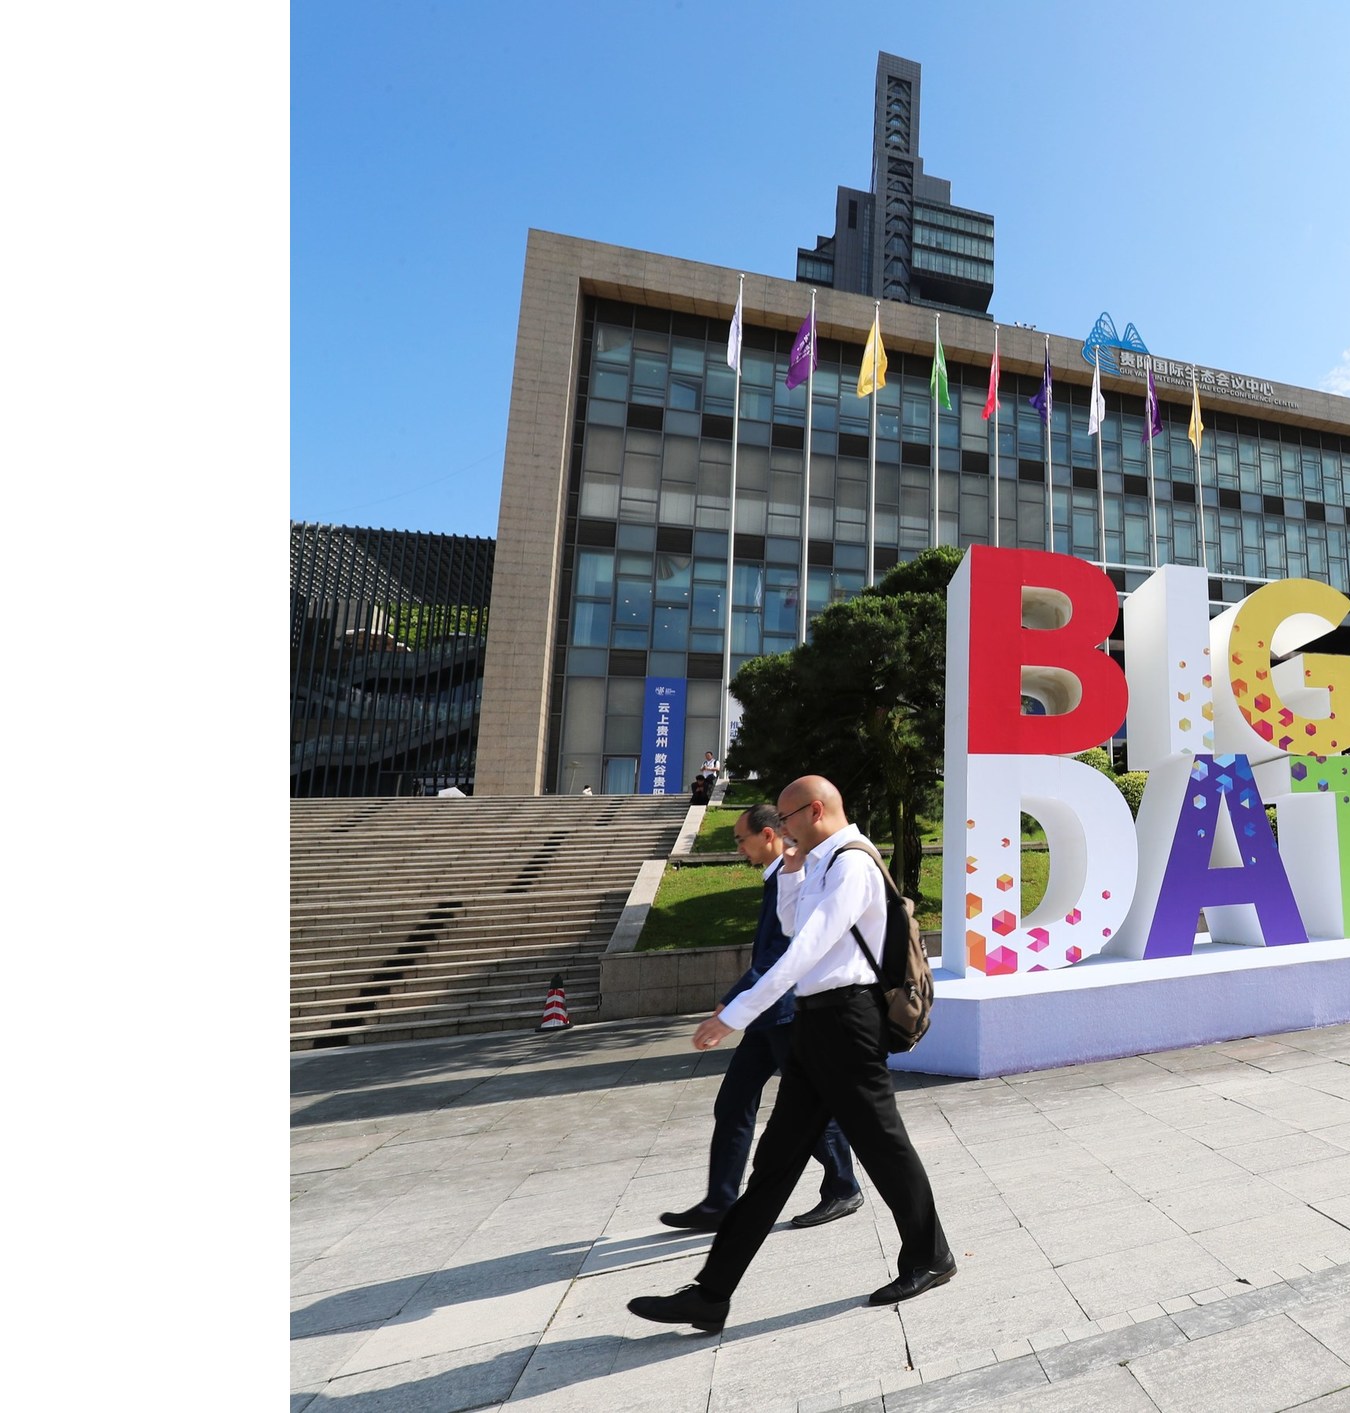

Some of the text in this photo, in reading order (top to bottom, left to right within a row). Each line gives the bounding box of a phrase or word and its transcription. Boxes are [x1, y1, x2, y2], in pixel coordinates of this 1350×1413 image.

[1120, 351, 1274, 397] 贵阳国际生态会议中心
[1120, 367, 1150, 379] GUIYAN
[1154, 374, 1211, 391] INTERNATINAL
[1274, 398, 1299, 409] CENTER
[656, 702, 670, 748] 云上贵州
